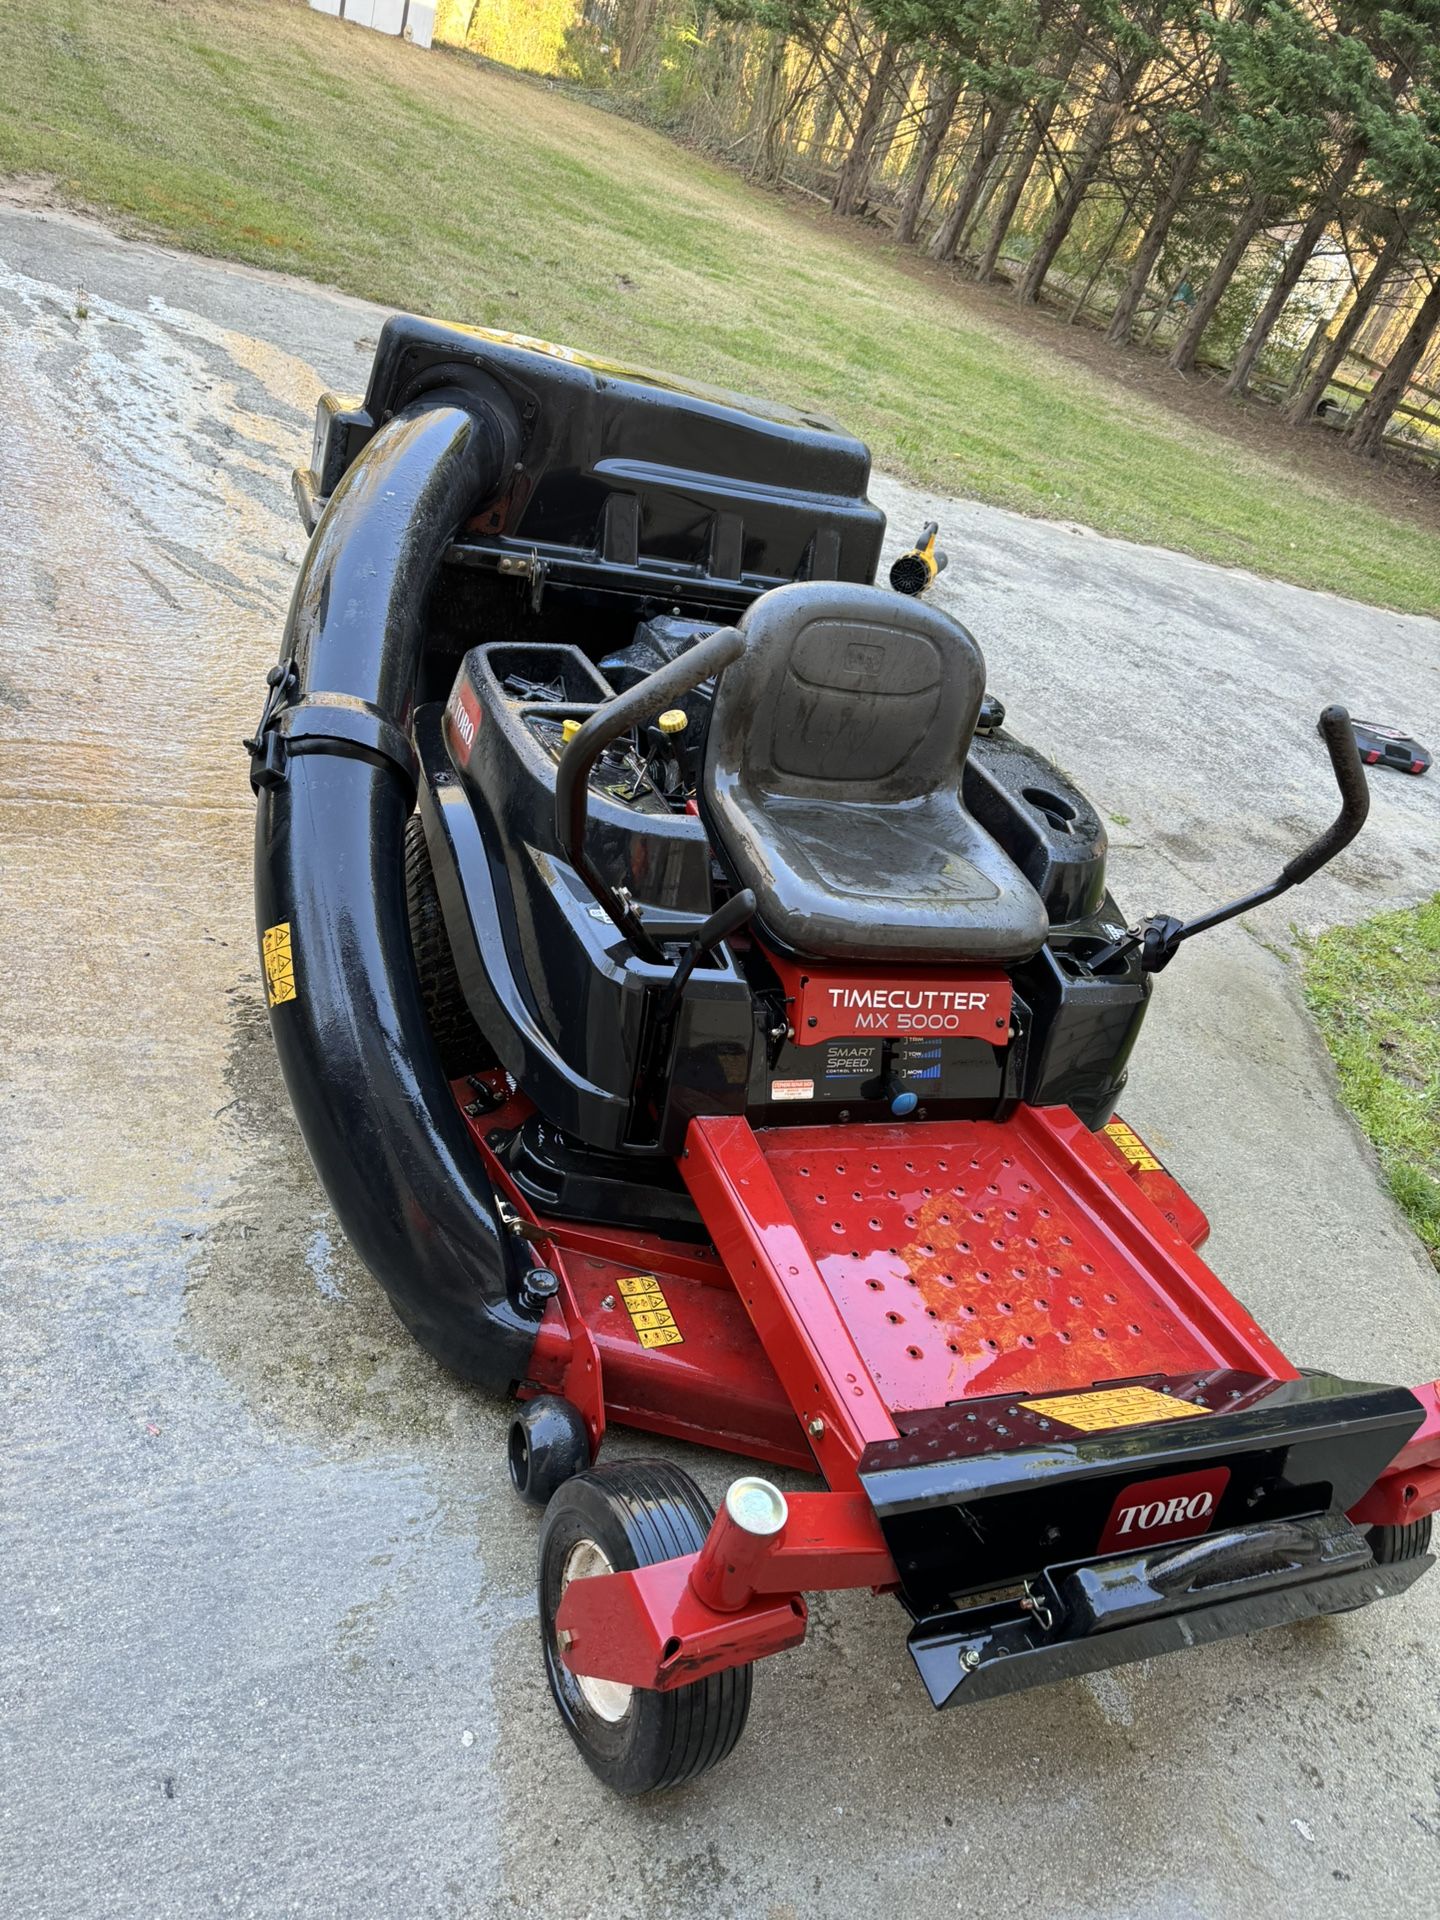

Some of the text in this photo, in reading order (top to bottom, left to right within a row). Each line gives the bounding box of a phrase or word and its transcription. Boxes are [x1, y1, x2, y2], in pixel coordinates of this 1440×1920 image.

[454, 696, 475, 746] TORO
[828, 988, 988, 1010] TIMECUTTER
[855, 1013, 960, 1030] MX 5000
[826, 1047, 876, 1058] SMART
[826, 1058, 870, 1068] SPEED
[1115, 1491, 1213, 1535] TORO
